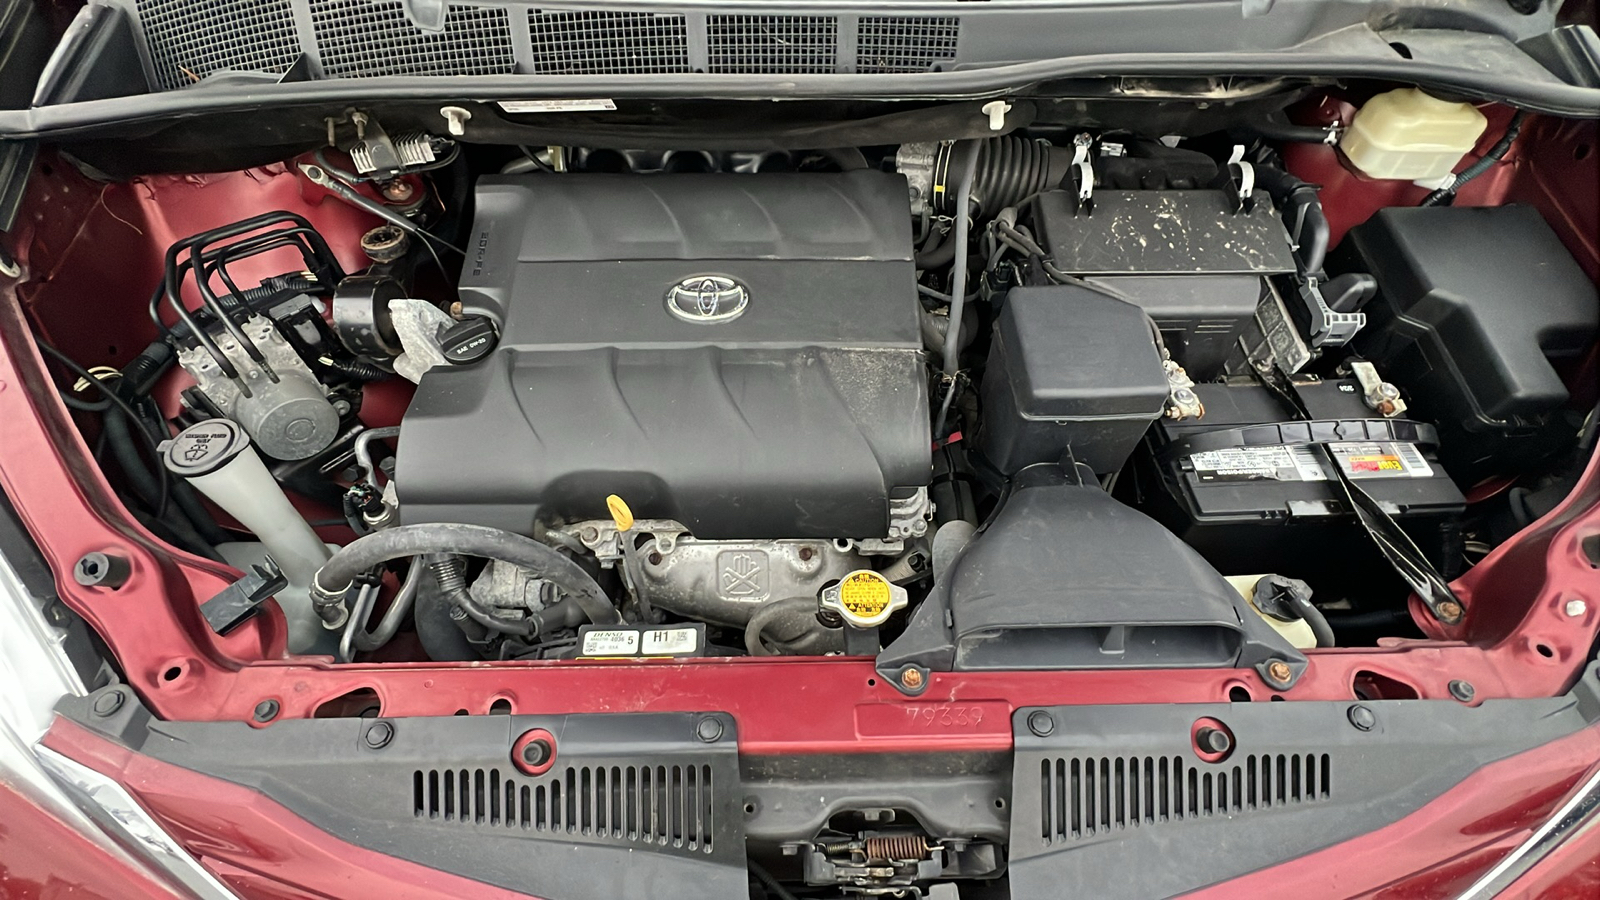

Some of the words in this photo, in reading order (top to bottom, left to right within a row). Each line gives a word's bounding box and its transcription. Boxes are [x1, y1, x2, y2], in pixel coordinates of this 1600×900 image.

[456, 345, 469, 355] SAE
[469, 337, 487, 349] 0W-20
[627, 636, 634, 645] 5
[653, 631, 669, 643] H1
[906, 707, 984, 727] 79339
